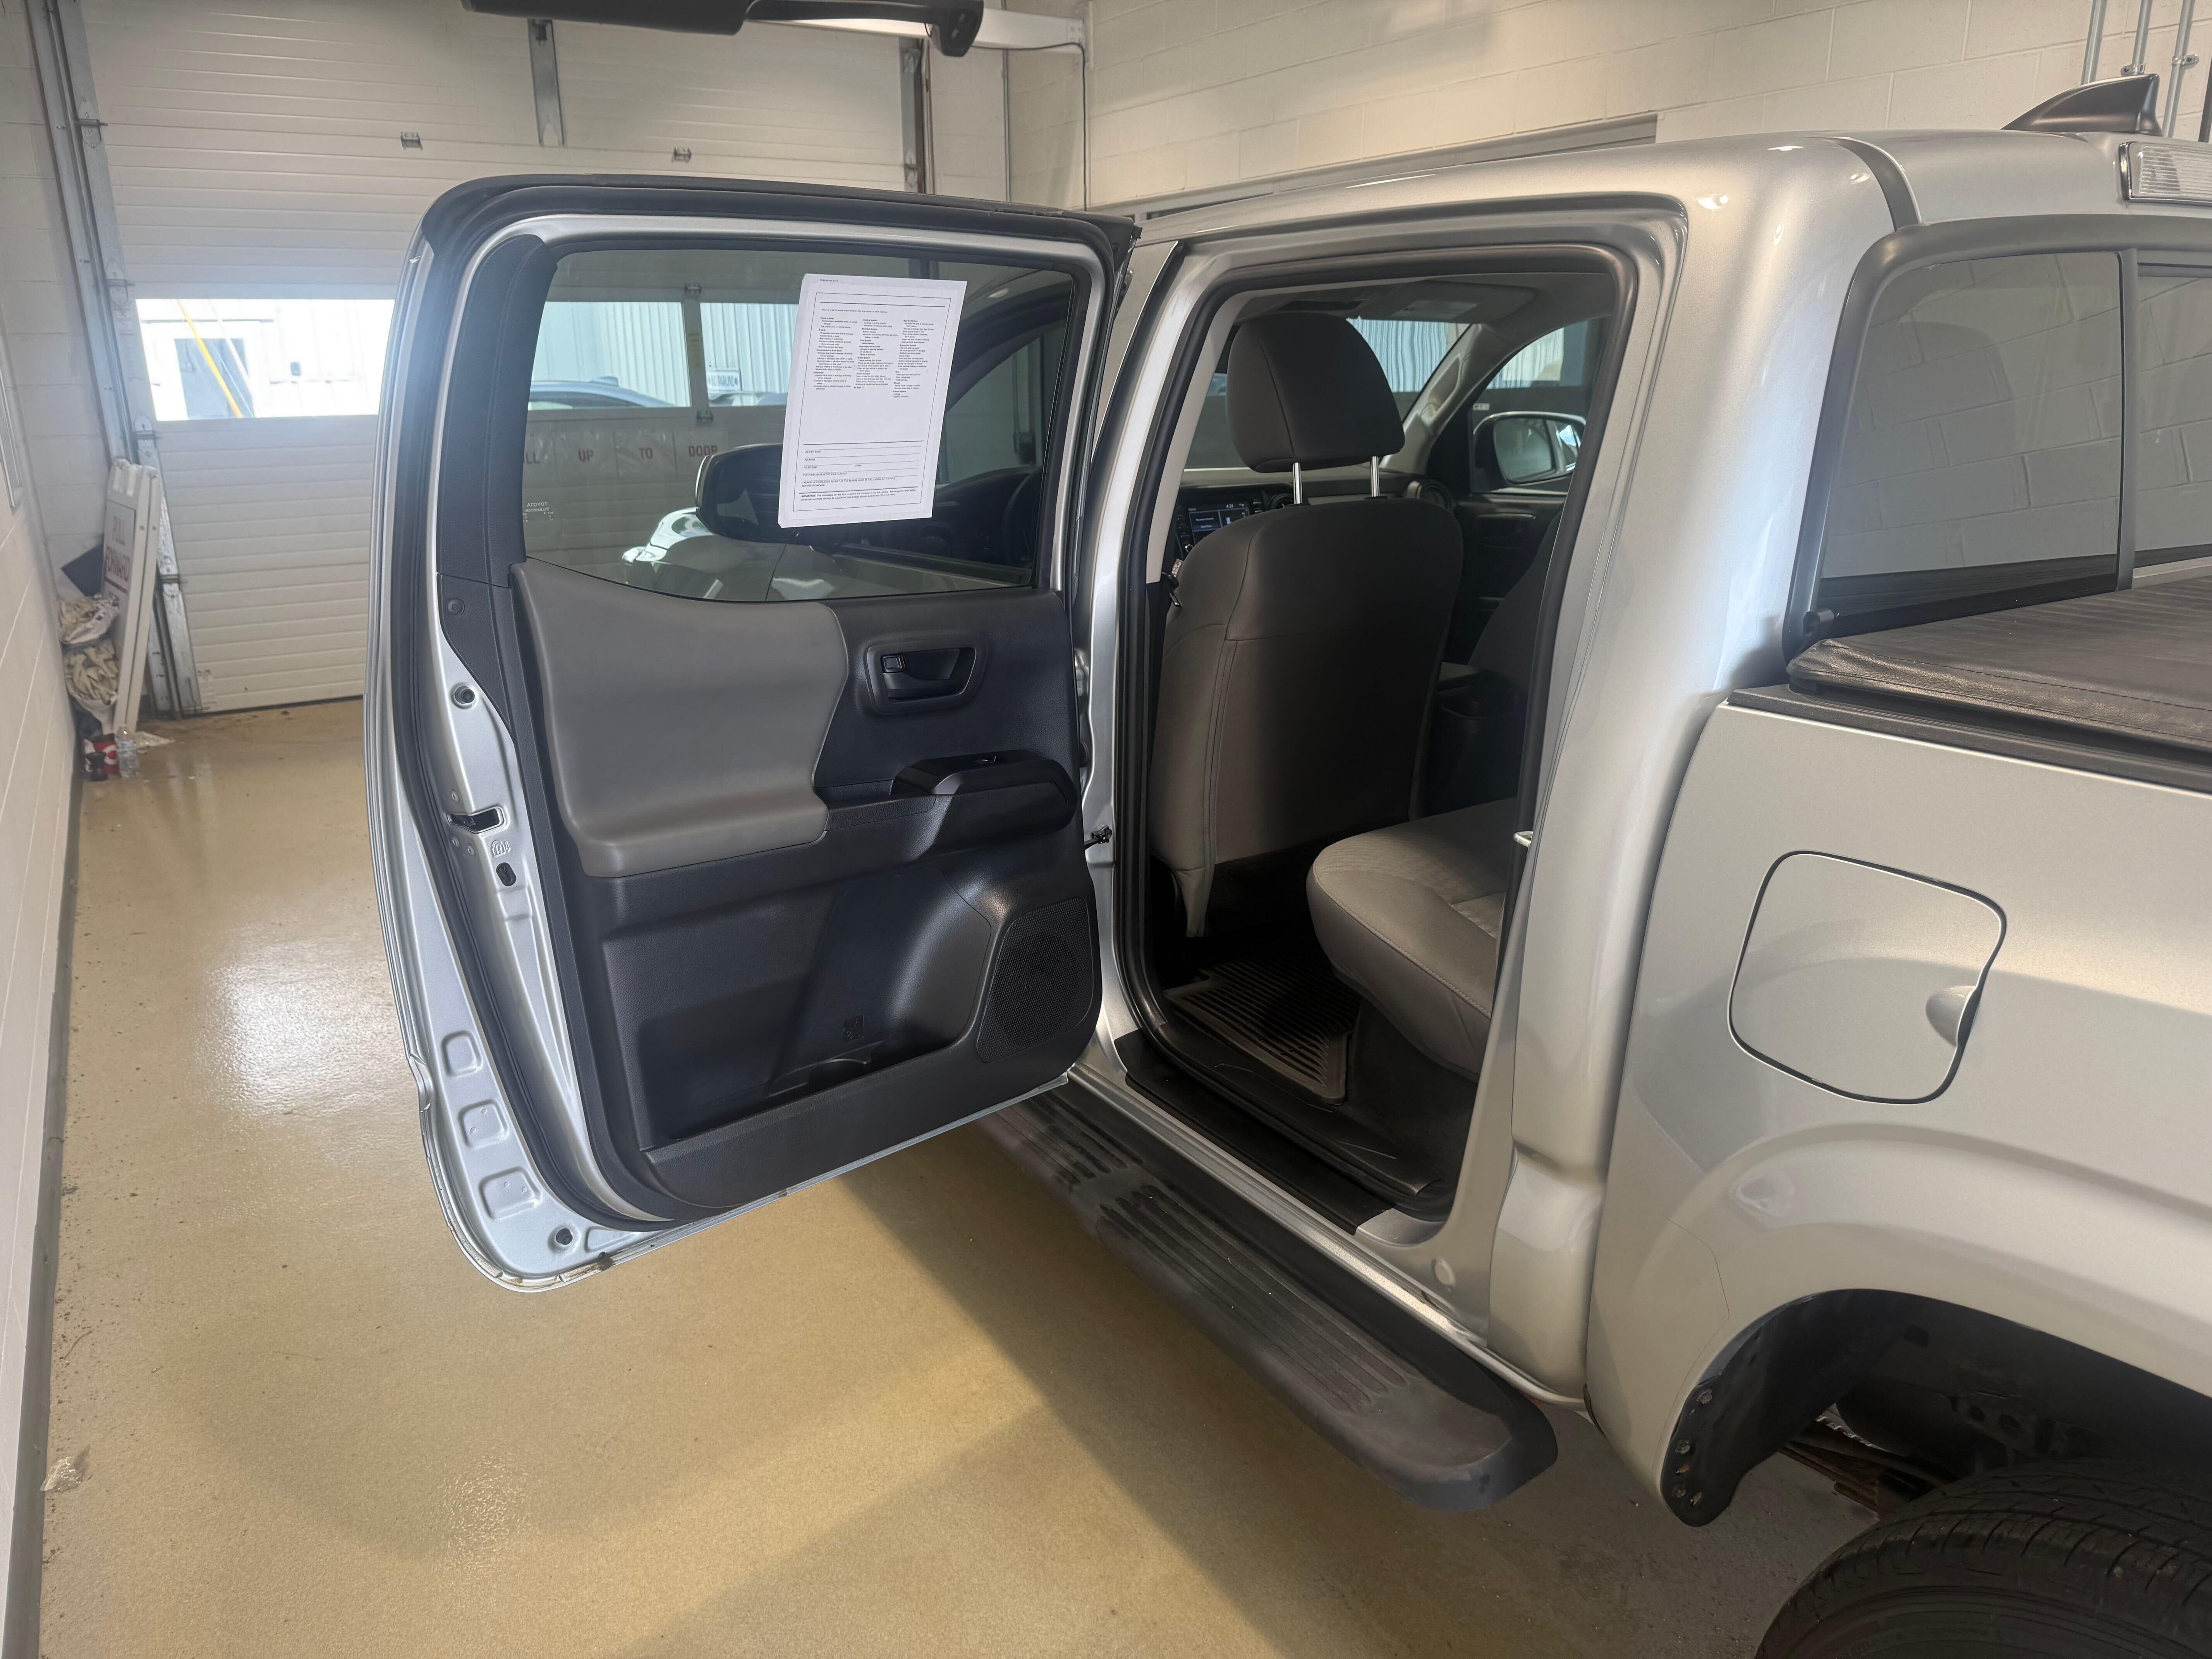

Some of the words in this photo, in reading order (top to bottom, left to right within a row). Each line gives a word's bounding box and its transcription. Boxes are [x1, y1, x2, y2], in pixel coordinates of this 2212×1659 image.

[578, 449, 594, 462] UP
[639, 447, 653, 459] TO
[689, 446, 718, 457] DOOR
[112, 515, 125, 546] PULL
